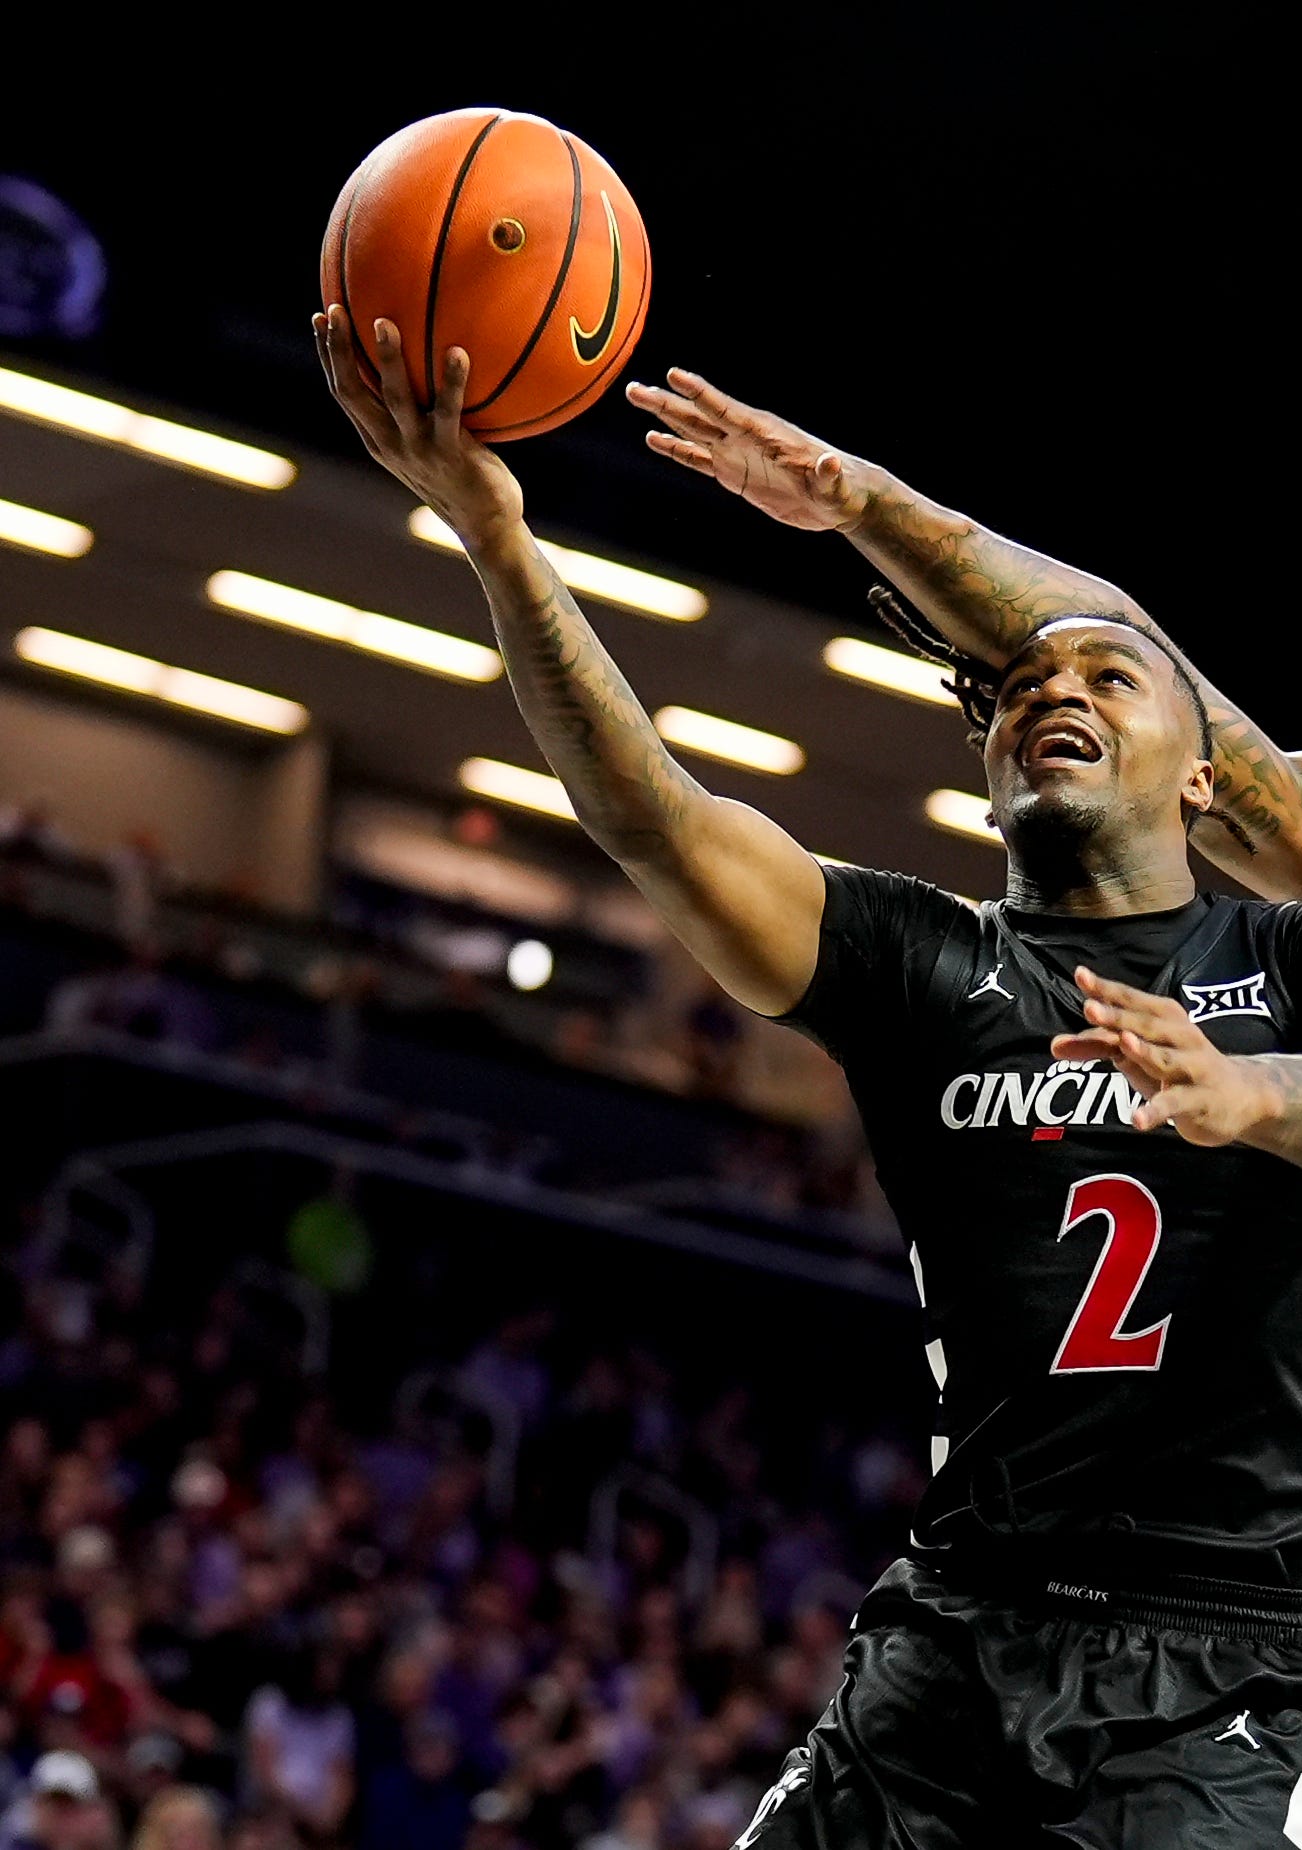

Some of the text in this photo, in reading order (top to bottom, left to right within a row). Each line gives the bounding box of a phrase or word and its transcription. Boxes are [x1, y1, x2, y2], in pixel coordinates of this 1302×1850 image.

[1183, 973, 1270, 1023] XII
[941, 1072, 1150, 1130] CINCIN
[1049, 1173, 1172, 1374] 2
[1046, 1581, 1109, 1603] BEARCATS
